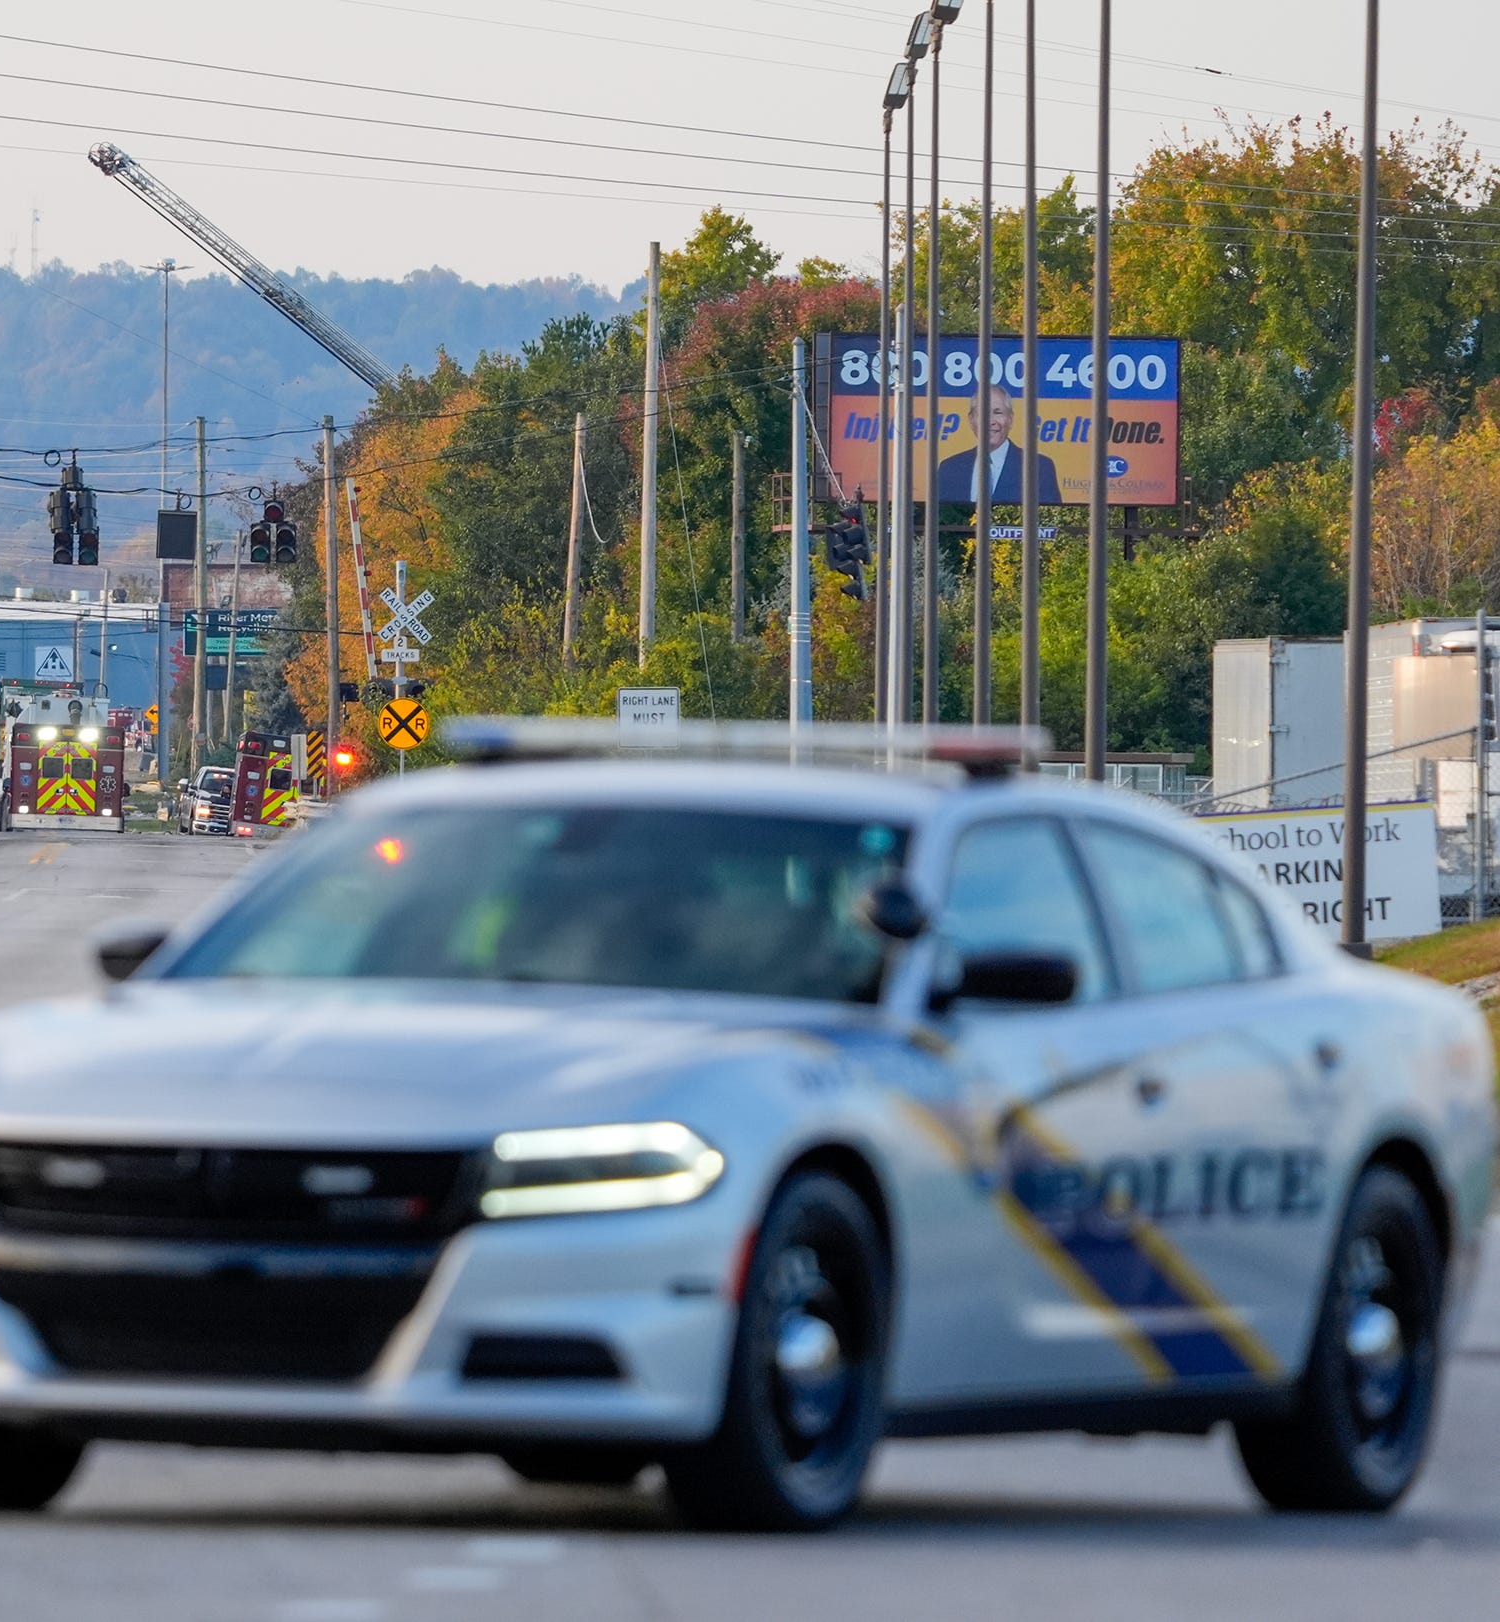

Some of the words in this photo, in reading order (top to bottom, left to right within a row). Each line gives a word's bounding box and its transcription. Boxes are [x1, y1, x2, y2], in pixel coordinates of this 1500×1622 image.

[944, 351, 1026, 388] 800
[1046, 353, 1167, 390] 4600
[1036, 415, 1068, 443] et
[1070, 415, 1092, 443] It
[990, 527, 1055, 538] OUTFNT
[380, 593, 431, 640] CROSSING
[382, 590, 402, 613] RAIL
[408, 618, 429, 641] ROAD
[397, 637, 404, 647] 2
[387, 651, 416, 659] TRACKS
[622, 696, 648, 706] RIGHT
[652, 696, 675, 706] LANE
[382, 717, 393, 729] R
[415, 718, 425, 730] R
[633, 712, 665, 725] MUST
[1220, 824, 1288, 852] hool
[1296, 826, 1322, 847] to
[1256, 859, 1344, 885] ARKIN
